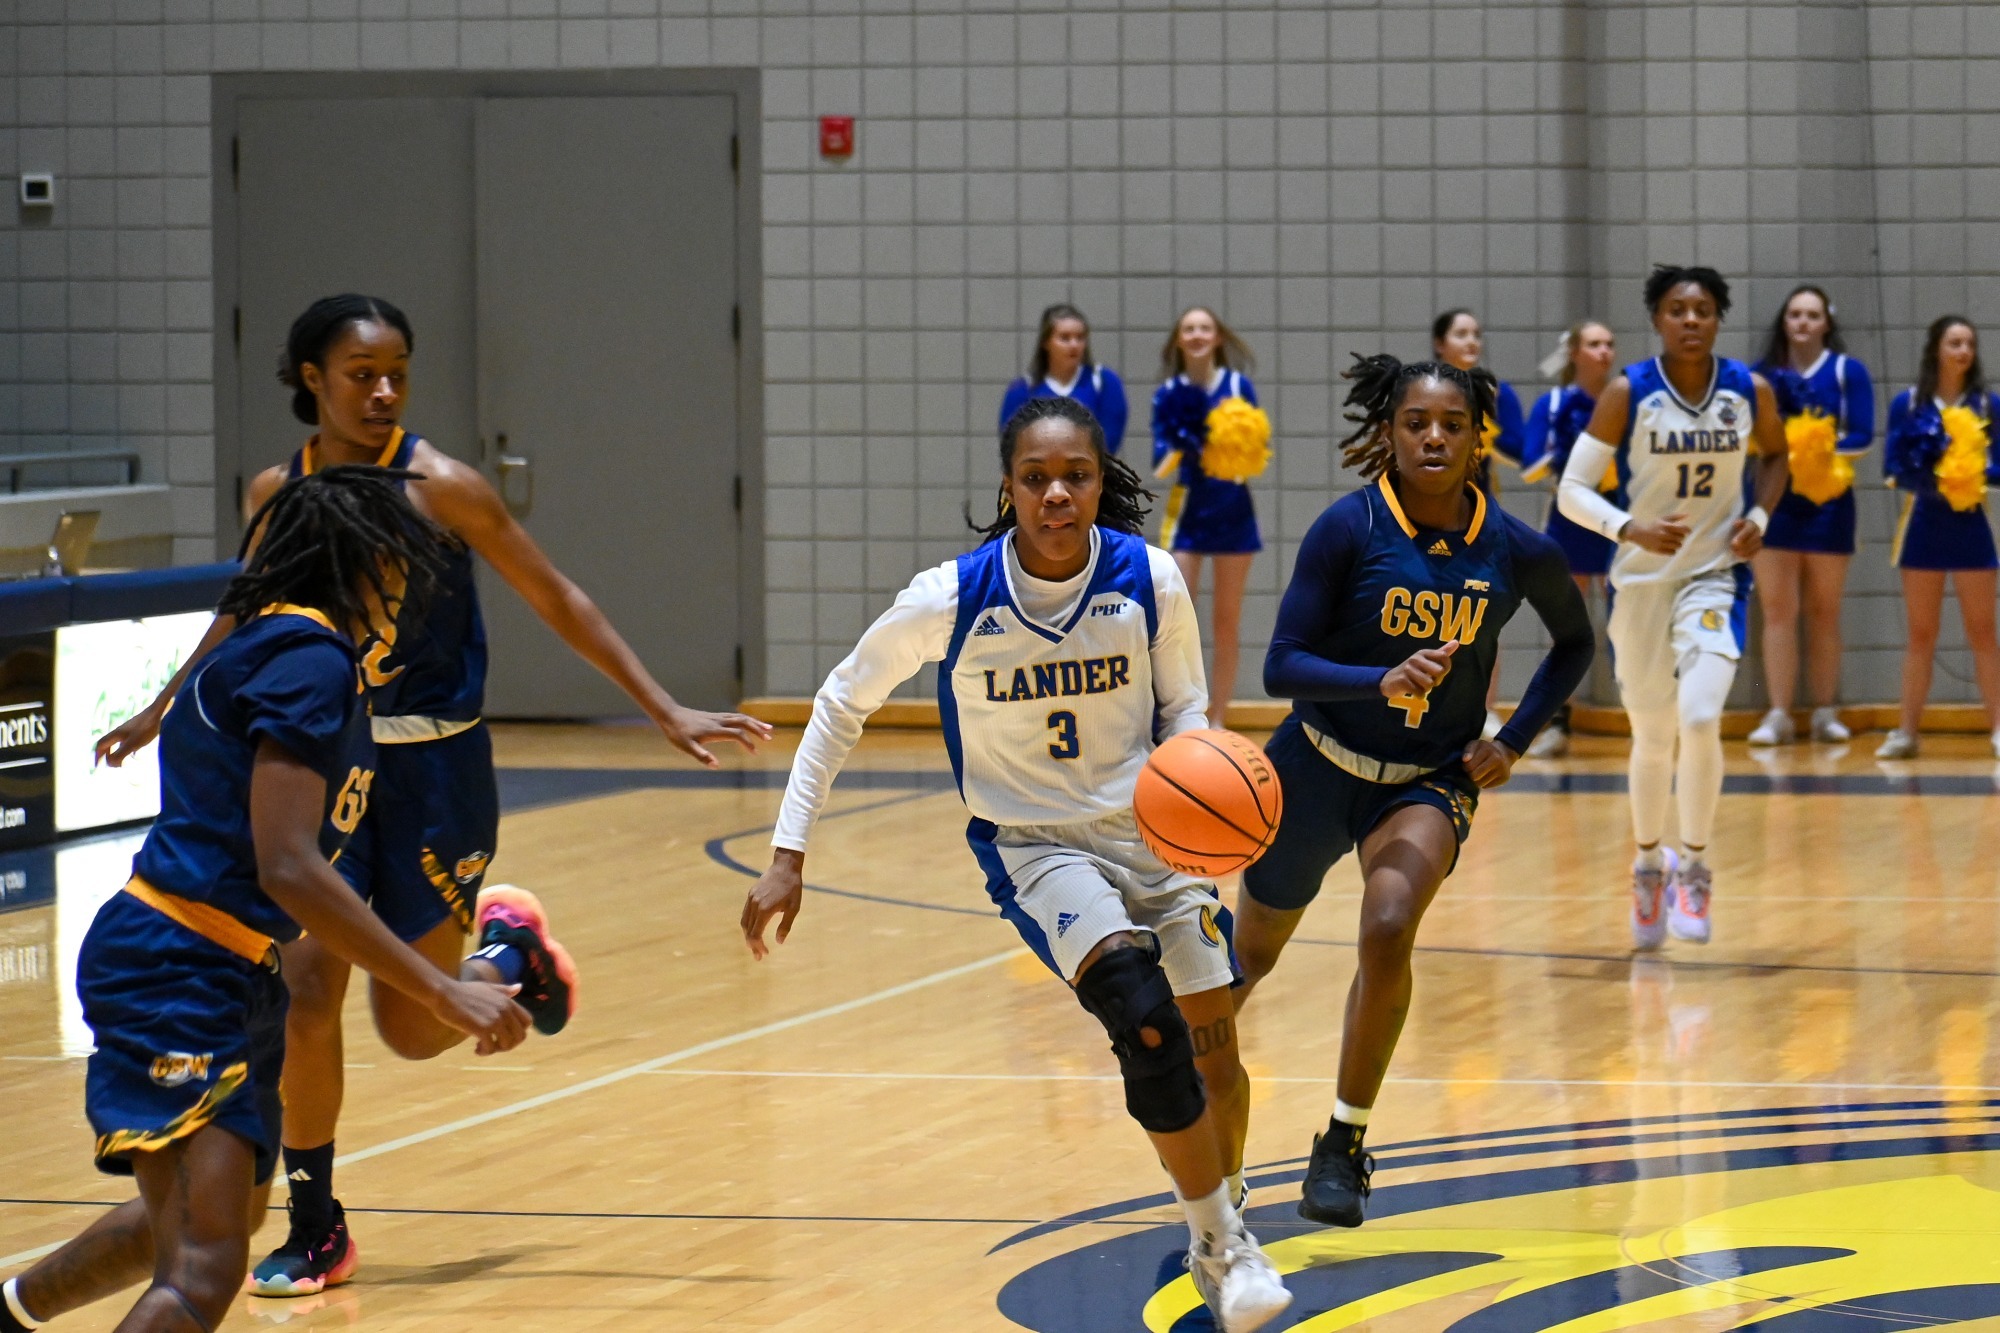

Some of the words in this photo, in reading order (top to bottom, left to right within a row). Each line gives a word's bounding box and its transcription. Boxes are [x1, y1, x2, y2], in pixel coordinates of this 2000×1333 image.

[1649, 430, 1740, 454] LANDER
[1676, 462, 1715, 498] 12
[1427, 548, 1452, 557] adidas
[1091, 602, 1128, 617] PBC
[1381, 587, 1489, 646] GSW
[973, 626, 1006, 637] adidas
[984, 654, 1131, 702] LANDER
[1387, 688, 1430, 729] 4
[1046, 708, 1082, 760] 3
[1057, 912, 1081, 939] adidas
